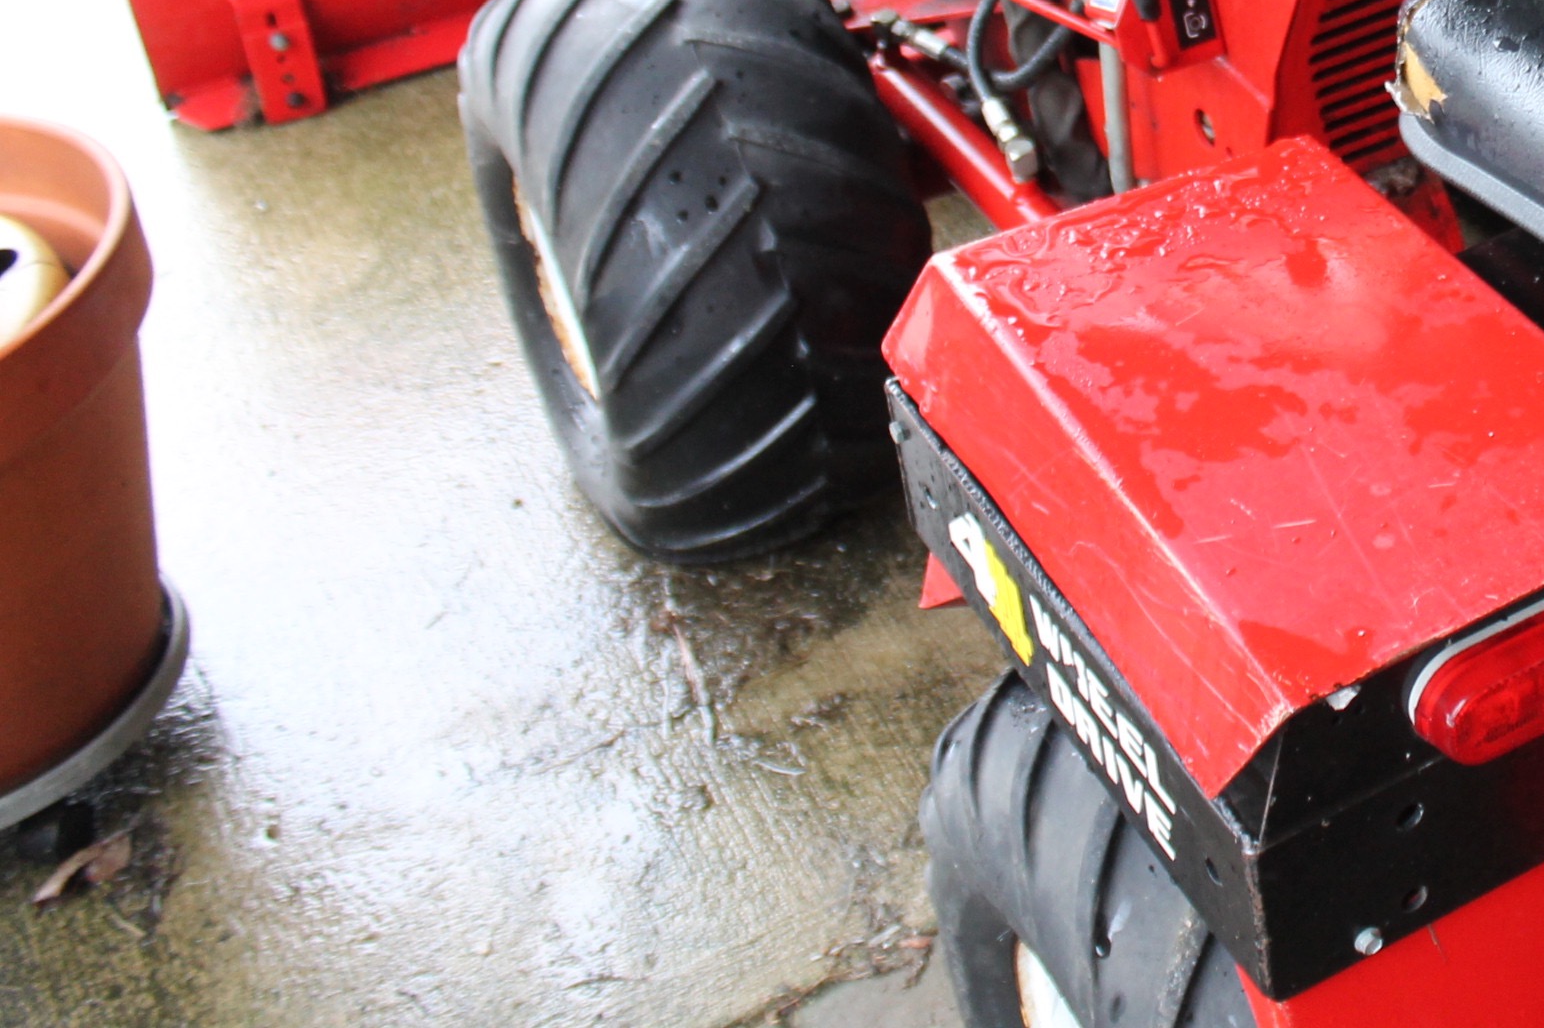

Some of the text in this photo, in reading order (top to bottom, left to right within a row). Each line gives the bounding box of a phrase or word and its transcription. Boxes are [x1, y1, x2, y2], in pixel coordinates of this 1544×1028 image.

[948, 512, 999, 610] 4
[1029, 594, 1177, 815] WHEEL
[1046, 661, 1177, 862] DRIVE
